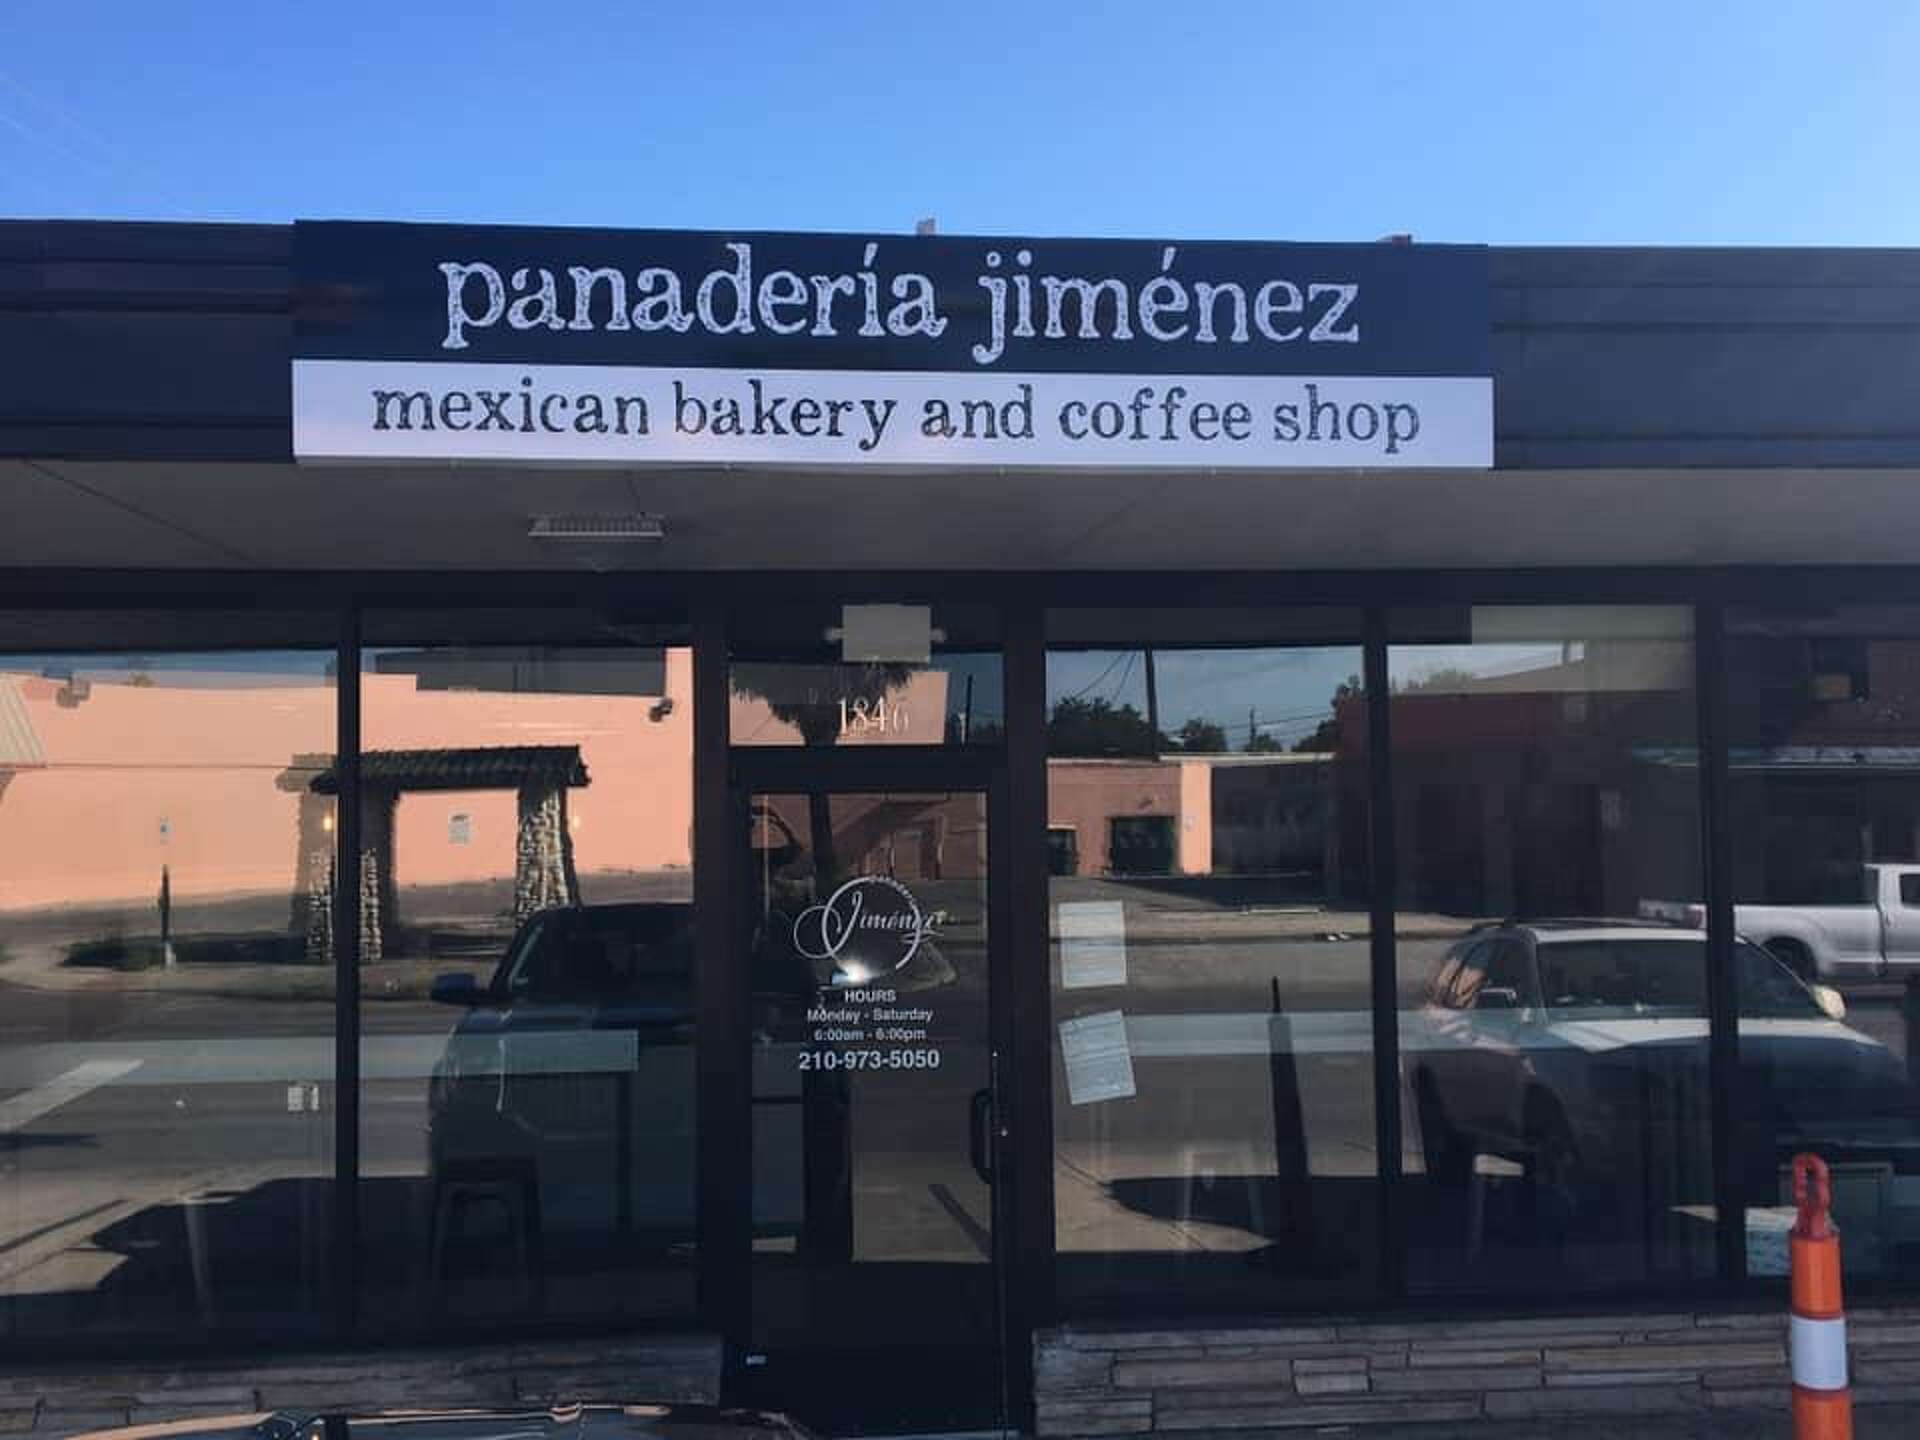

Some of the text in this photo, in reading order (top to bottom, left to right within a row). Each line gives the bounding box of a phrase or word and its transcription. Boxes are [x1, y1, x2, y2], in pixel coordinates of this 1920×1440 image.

[438, 243, 1360, 364] panadería jiménez
[372, 376, 1421, 454] mexican bakery and coffee shop
[845, 989, 896, 1003] HOURS
[807, 1009, 860, 1024] Monday
[873, 1008, 933, 1023] Saturday
[814, 1028, 864, 1041] 6:00am
[875, 1027, 927, 1043] 6:00pm
[799, 1049, 940, 1070] 210-973-5050
